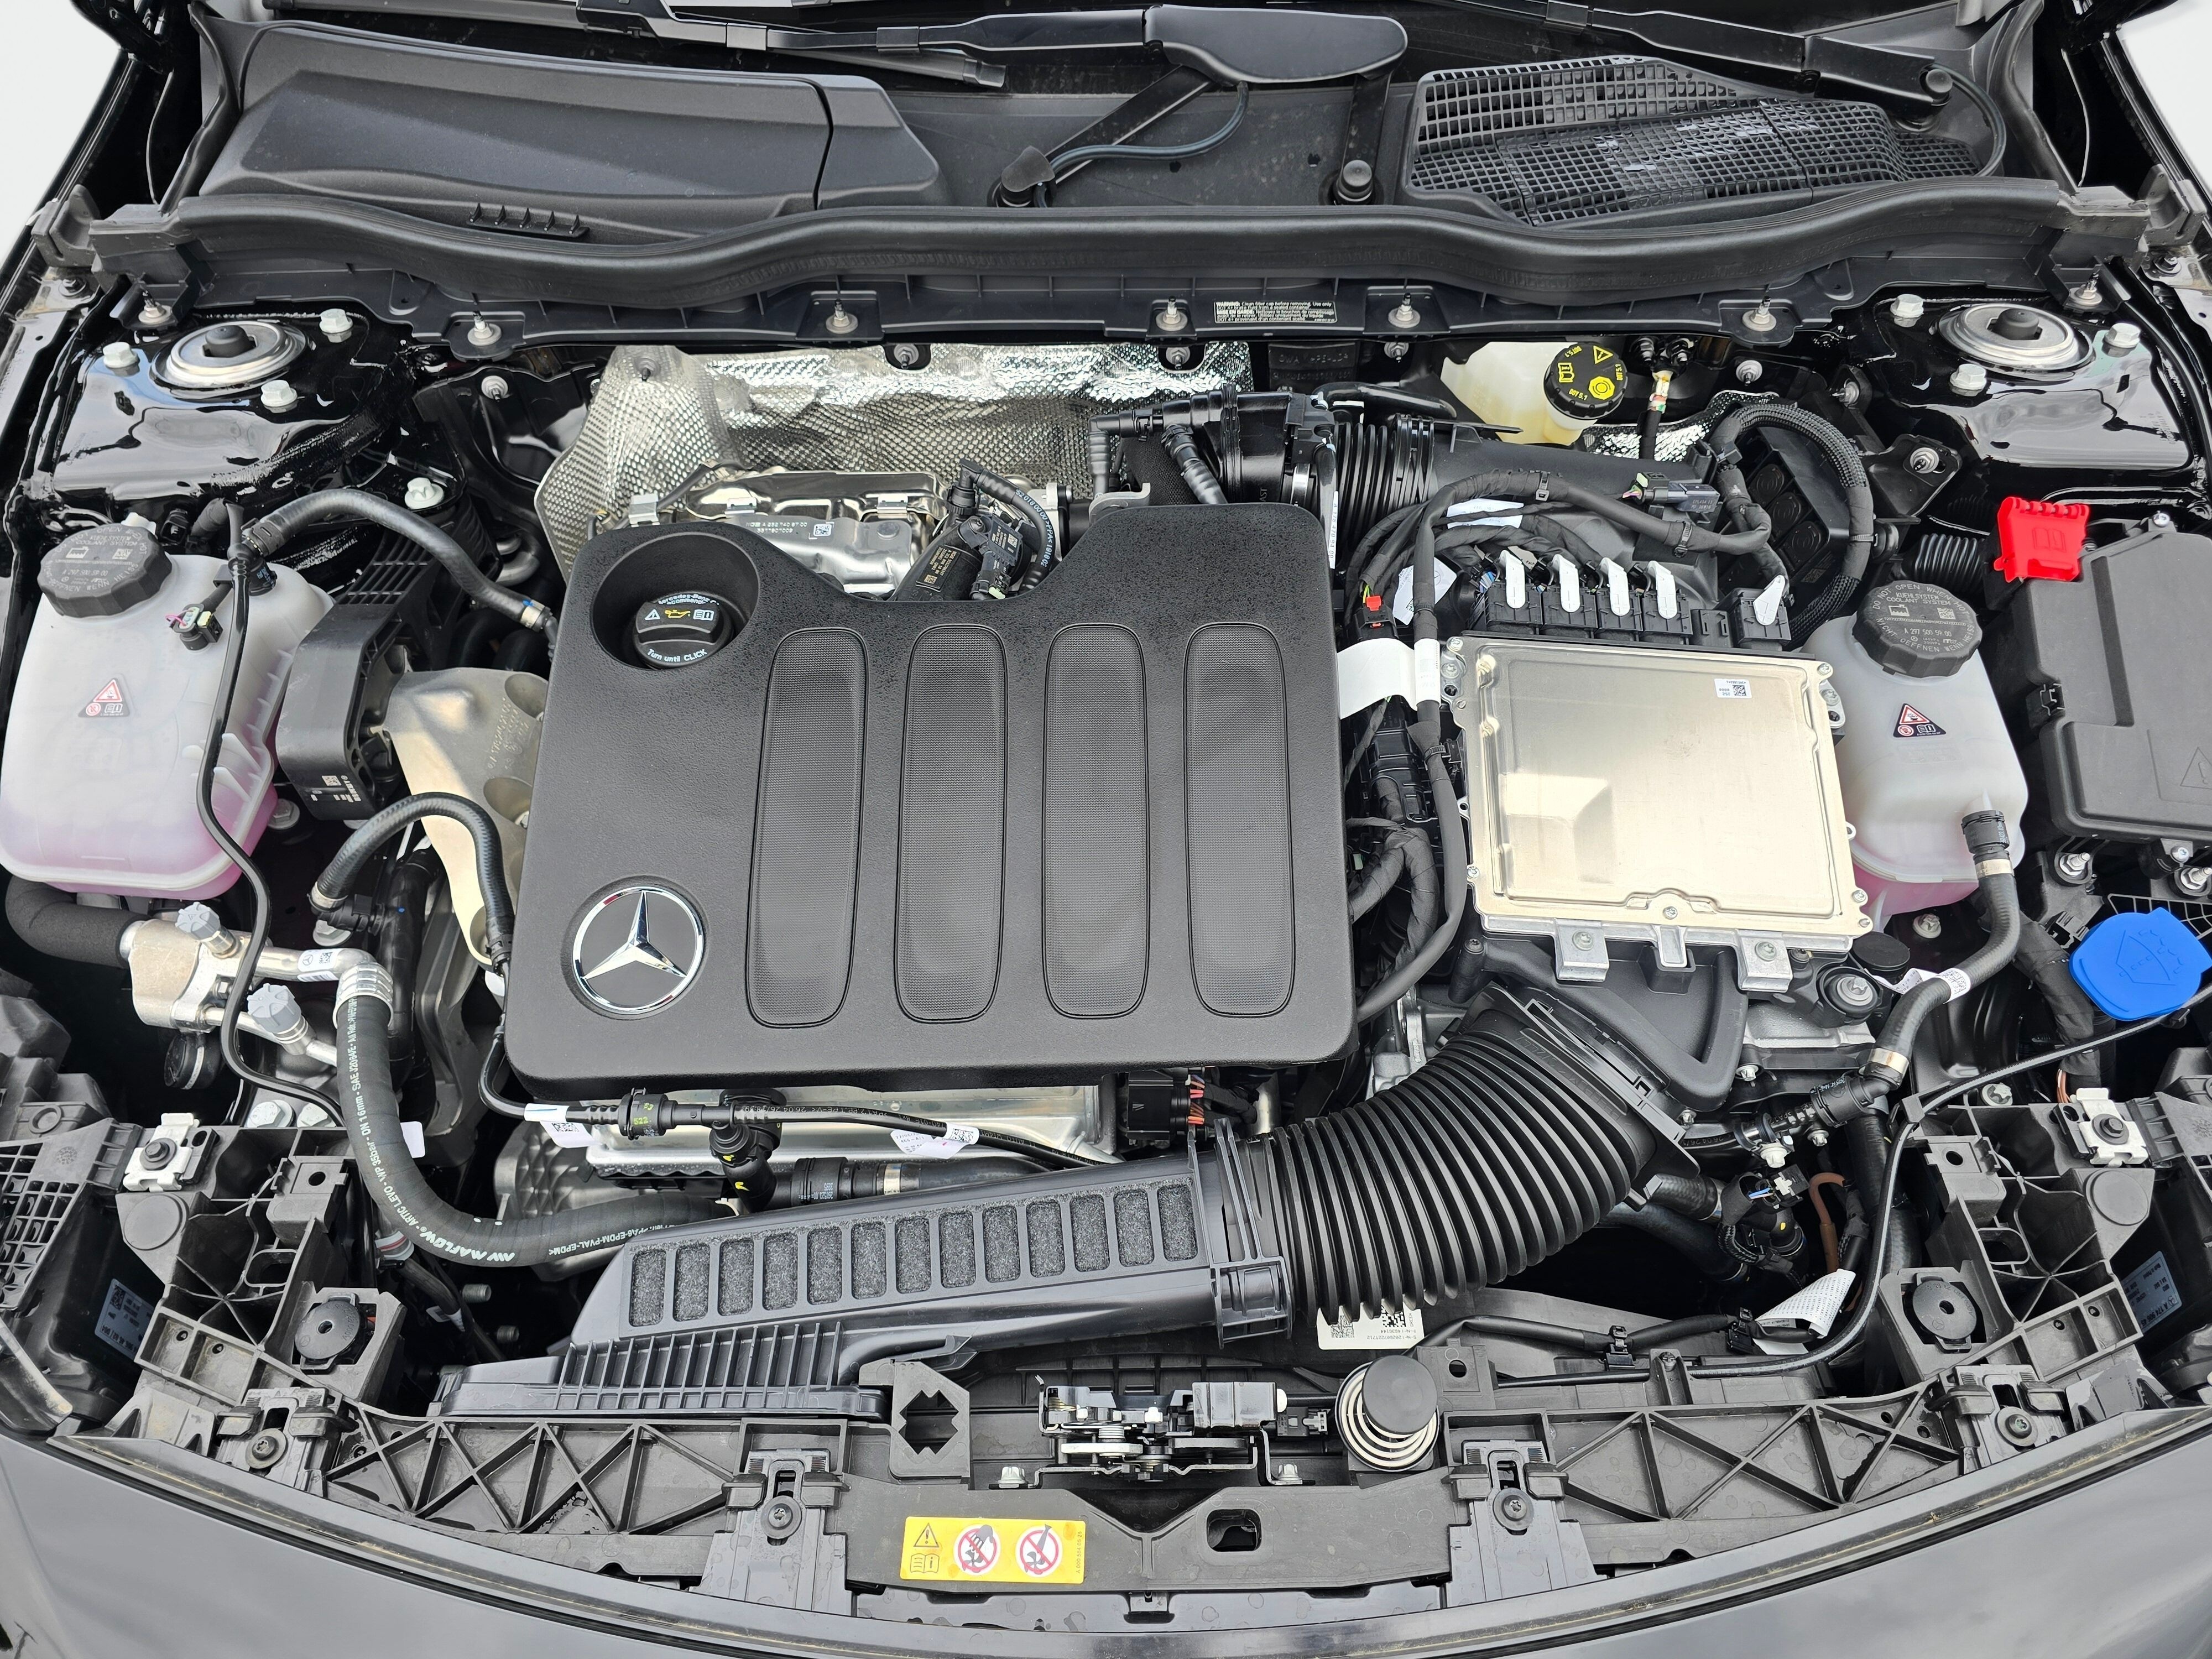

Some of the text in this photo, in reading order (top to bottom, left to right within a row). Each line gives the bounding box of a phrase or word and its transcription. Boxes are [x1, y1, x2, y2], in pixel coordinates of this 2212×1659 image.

[1568, 388, 1588, 401] DOT 5.1
[1872, 600, 1881, 609] DO
[1877, 588, 1892, 599] NOT
[1927, 586, 1952, 601] WHEN
[1953, 602, 1970, 615] HOT
[1876, 618, 1898, 637] NICHT
[1900, 638, 1940, 653] OEFFNEN
[1944, 641, 1964, 651] WENN
[1964, 624, 1975, 643] HEISS
[647, 648, 662, 661] Turn
[684, 649, 708, 661] CLICK
[350, 1072, 361, 1091] SAE
[359, 1122, 372, 1136] DN
[367, 1141, 382, 1167] 35bar
[374, 1167, 387, 1182] WP
[384, 1186, 403, 1208] LEVO
[397, 1206, 419, 1226] ARTIC
[420, 1230, 488, 1260] MAFLOW
